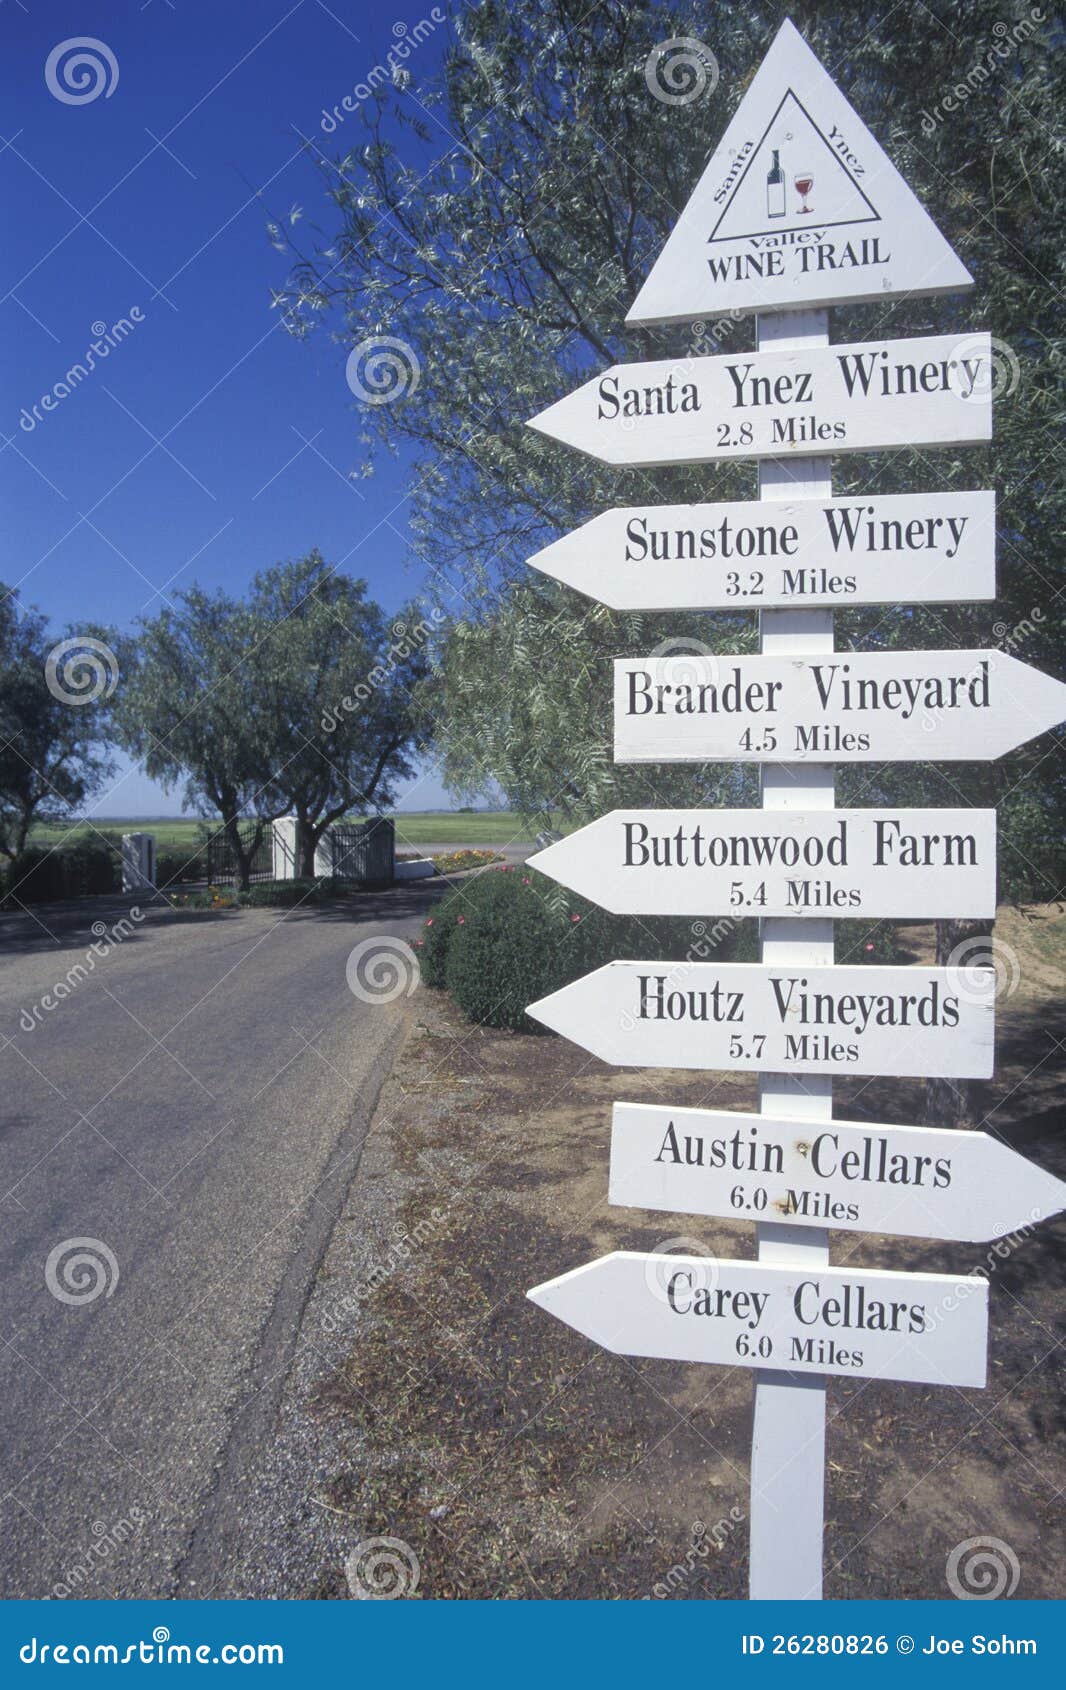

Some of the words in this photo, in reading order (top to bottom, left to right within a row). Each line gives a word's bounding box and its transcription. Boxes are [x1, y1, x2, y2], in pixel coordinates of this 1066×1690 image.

[713, 140, 755, 205] Santa
[827, 126, 867, 179] Ynez
[707, 250, 784, 283] WINE
[795, 238, 891, 274] TRAIL
[749, 231, 828, 248] Valley
[597, 374, 701, 420] Santa
[725, 364, 814, 408] Ynez
[838, 351, 984, 399] Winery
[717, 421, 754, 448] 2.8
[771, 417, 847, 444] Miles
[625, 517, 799, 562] Sunstone
[823, 507, 968, 558] Winery
[726, 571, 764, 596] 3.2
[781, 569, 857, 595] Miles
[626, 668, 783, 716] Brander
[809, 662, 991, 719] Vineyard
[739, 727, 777, 752] 4.5
[795, 724, 871, 752] Miles
[622, 821, 848, 867] Buttonwood
[872, 820, 978, 866] Farm
[730, 882, 768, 906] 5.4
[785, 880, 862, 907] Miles
[636, 975, 745, 1023] Houtz
[768, 979, 961, 1035] Vineyards
[729, 1034, 767, 1059] 5.7
[784, 1034, 860, 1062] Miles
[654, 1121, 784, 1174] Austin
[811, 1133, 952, 1189] Cellars
[730, 1185, 768, 1211] 6.0
[785, 1189, 860, 1221] Miles
[667, 1272, 770, 1329] Carey
[794, 1281, 926, 1335] Cellars
[735, 1334, 773, 1359] 6.0
[789, 1337, 864, 1368] Miles
